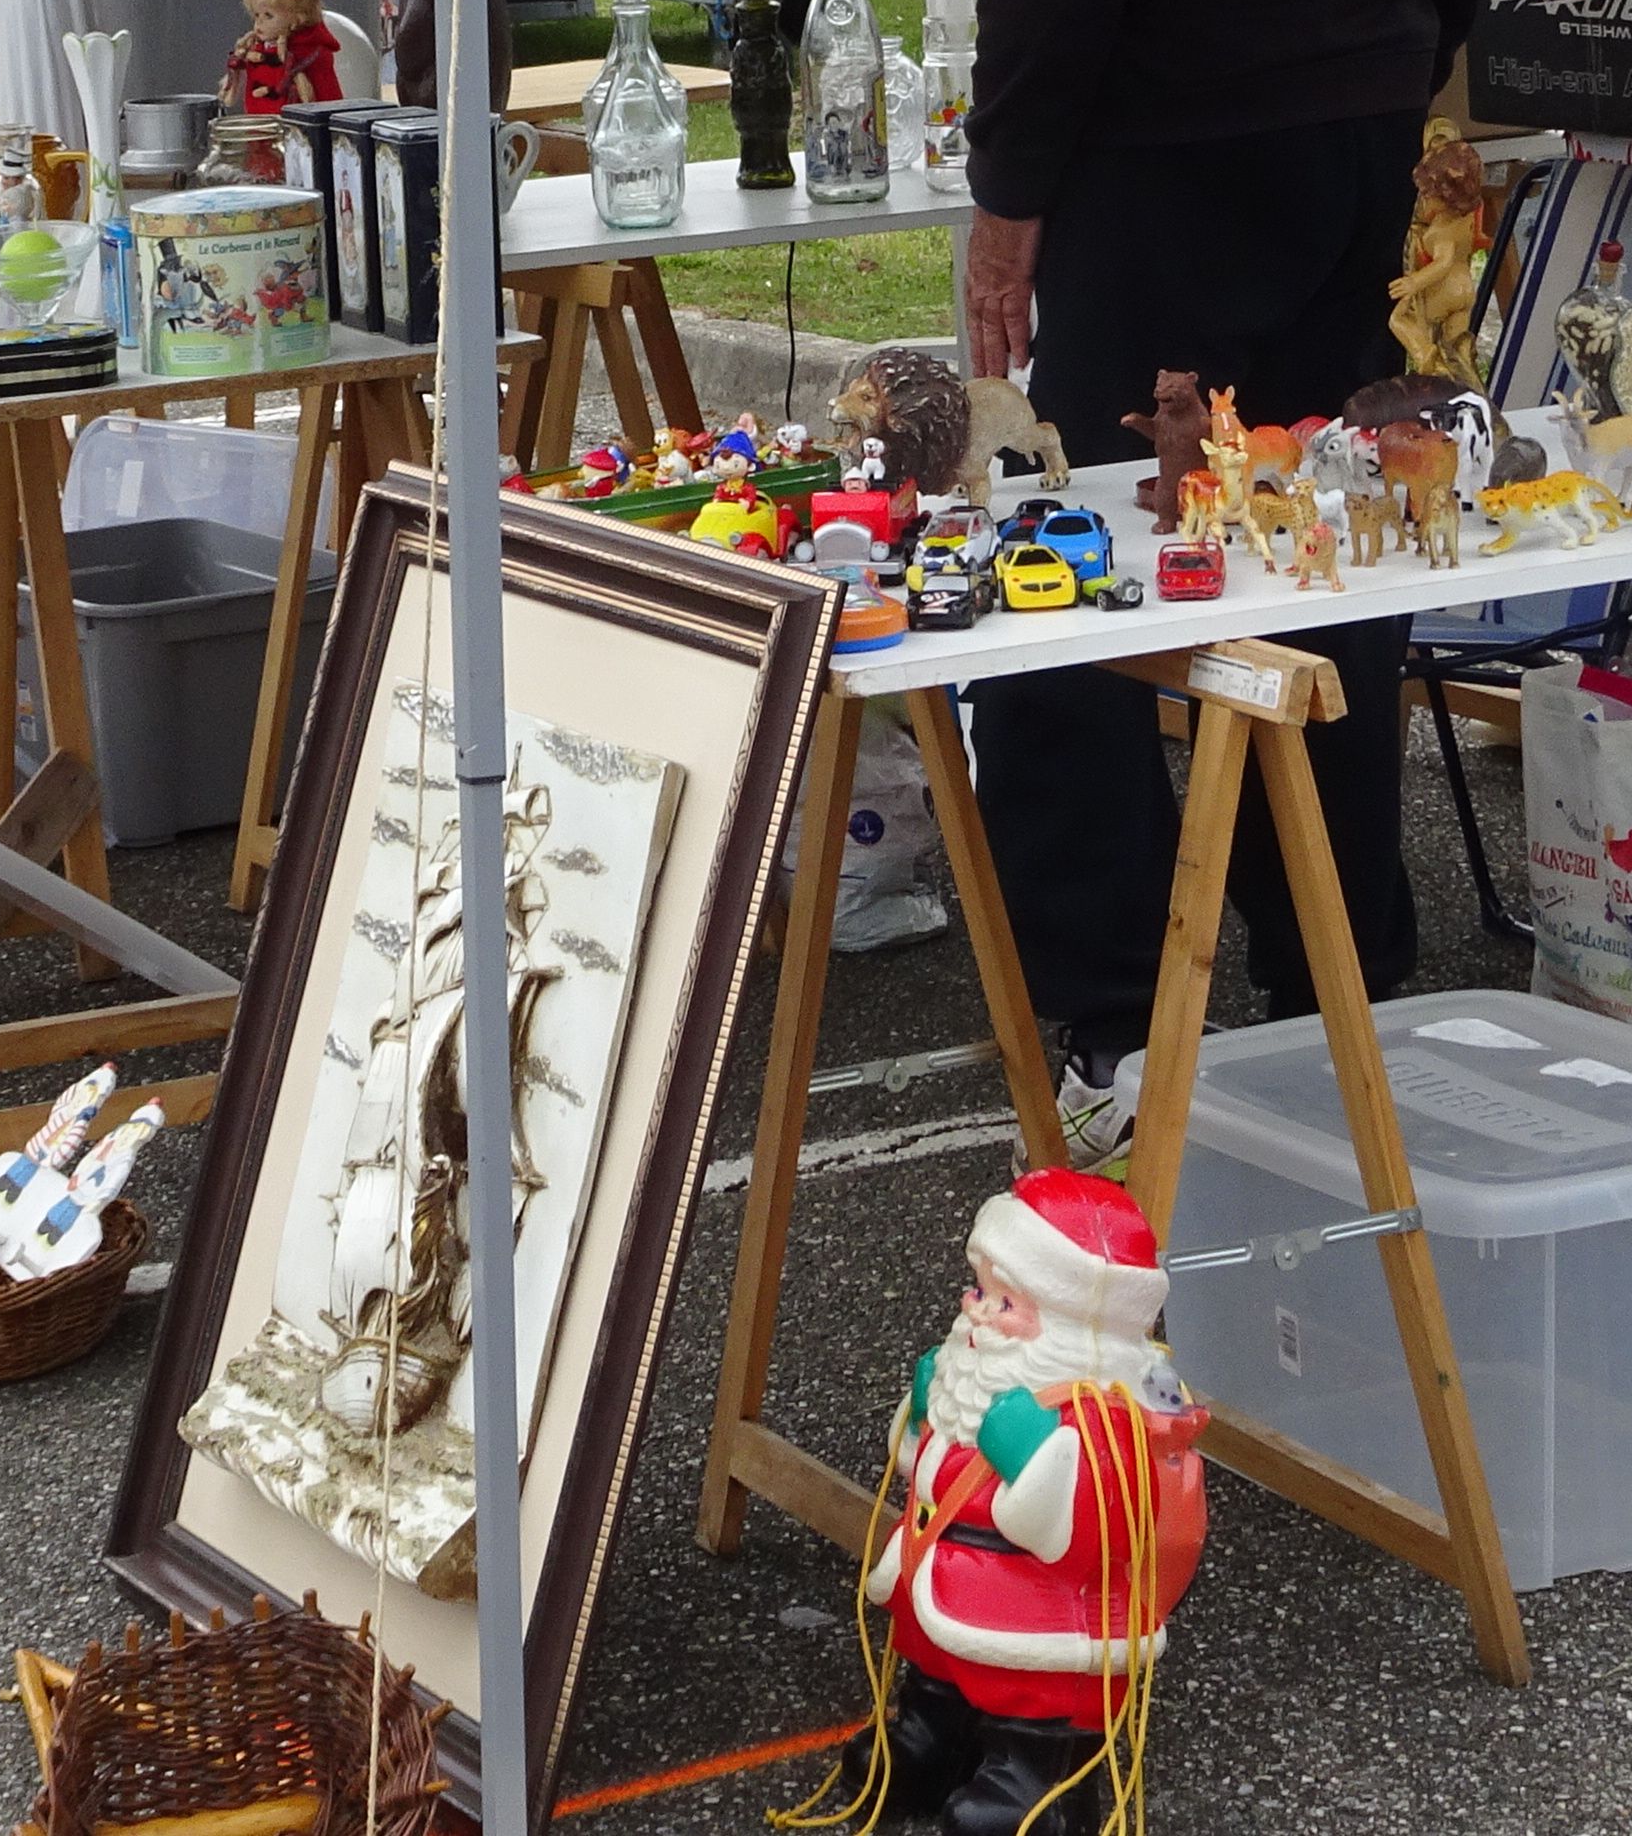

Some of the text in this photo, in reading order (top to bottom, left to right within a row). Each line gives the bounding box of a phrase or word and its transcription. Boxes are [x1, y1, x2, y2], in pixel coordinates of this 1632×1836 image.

[1488, 55, 1614, 97] High-end
[199, 234, 301, 256] Le Corbeau et le Renard
